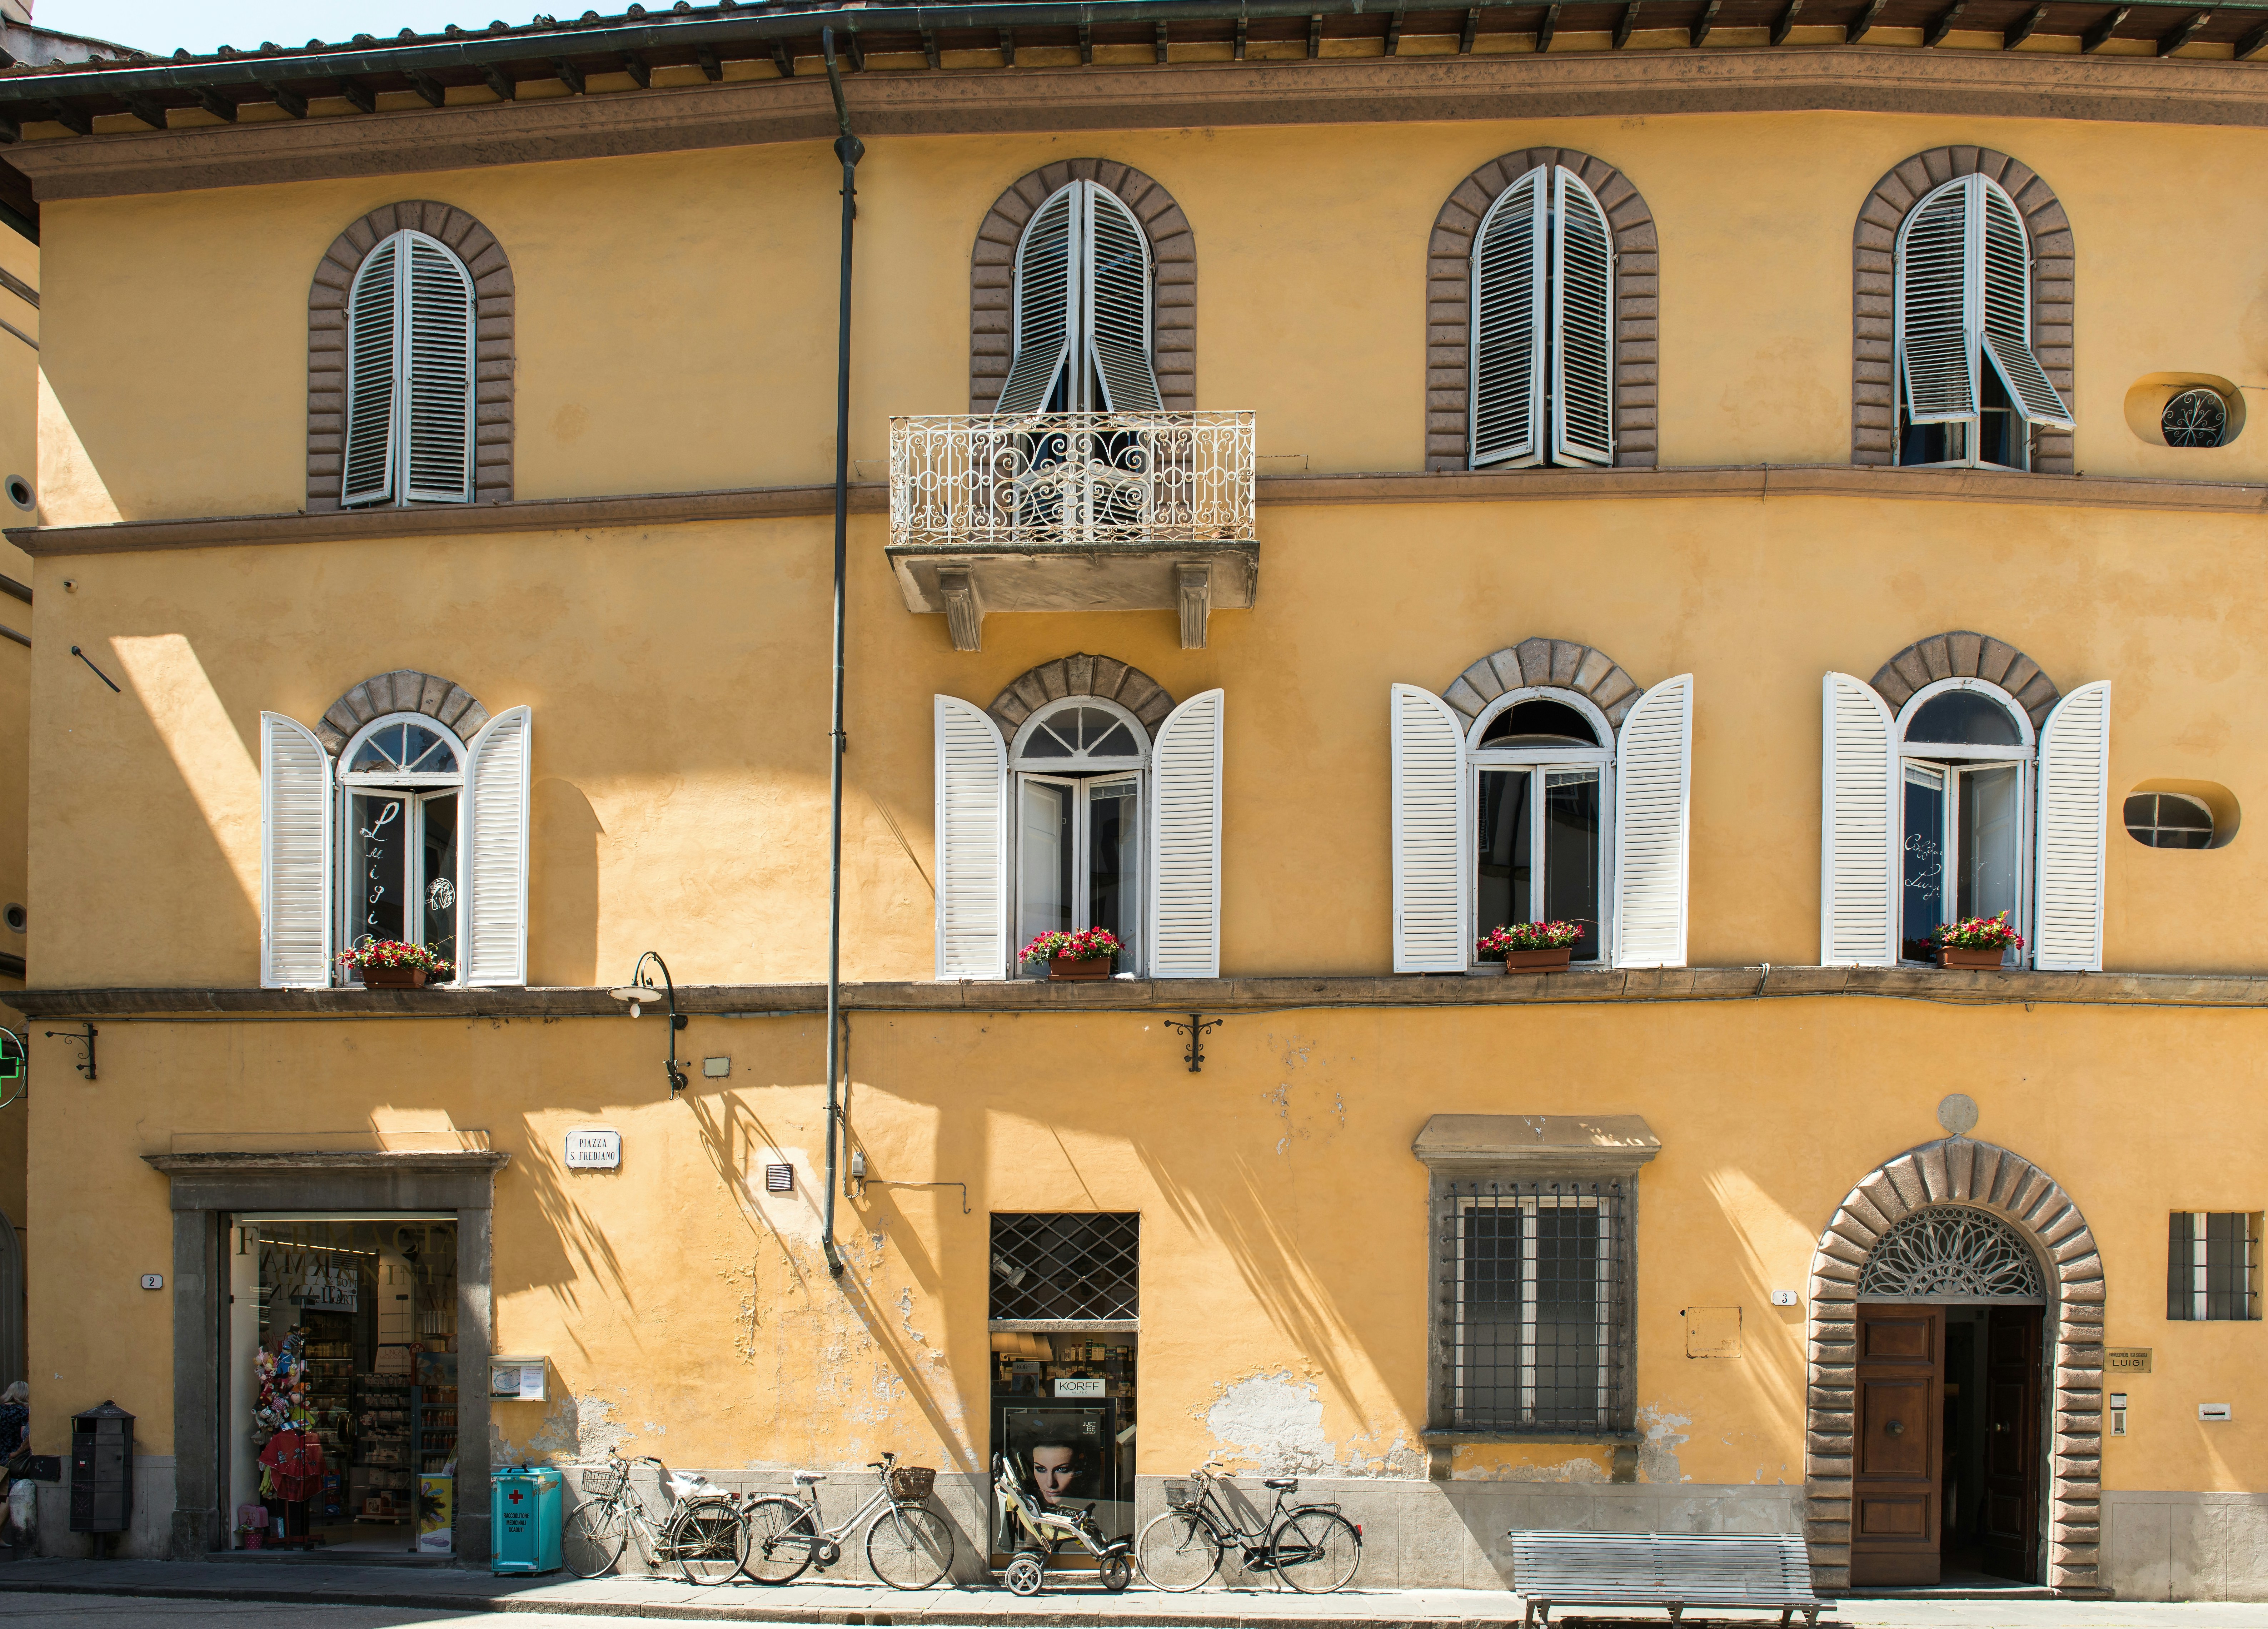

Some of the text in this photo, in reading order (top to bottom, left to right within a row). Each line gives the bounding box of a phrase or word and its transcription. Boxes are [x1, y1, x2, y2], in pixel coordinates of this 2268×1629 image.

[579, 1139, 607, 1147] PIAZZA
[570, 1152, 615, 1160] S. FREDIANO
[236, 1223, 457, 1255] FARMACIA
[275, 1264, 435, 1286] GIANNINI
[149, 1277, 155, 1287] 2
[1782, 1293, 1788, 1303] 3
[1060, 1382, 1100, 1390] KORFF
